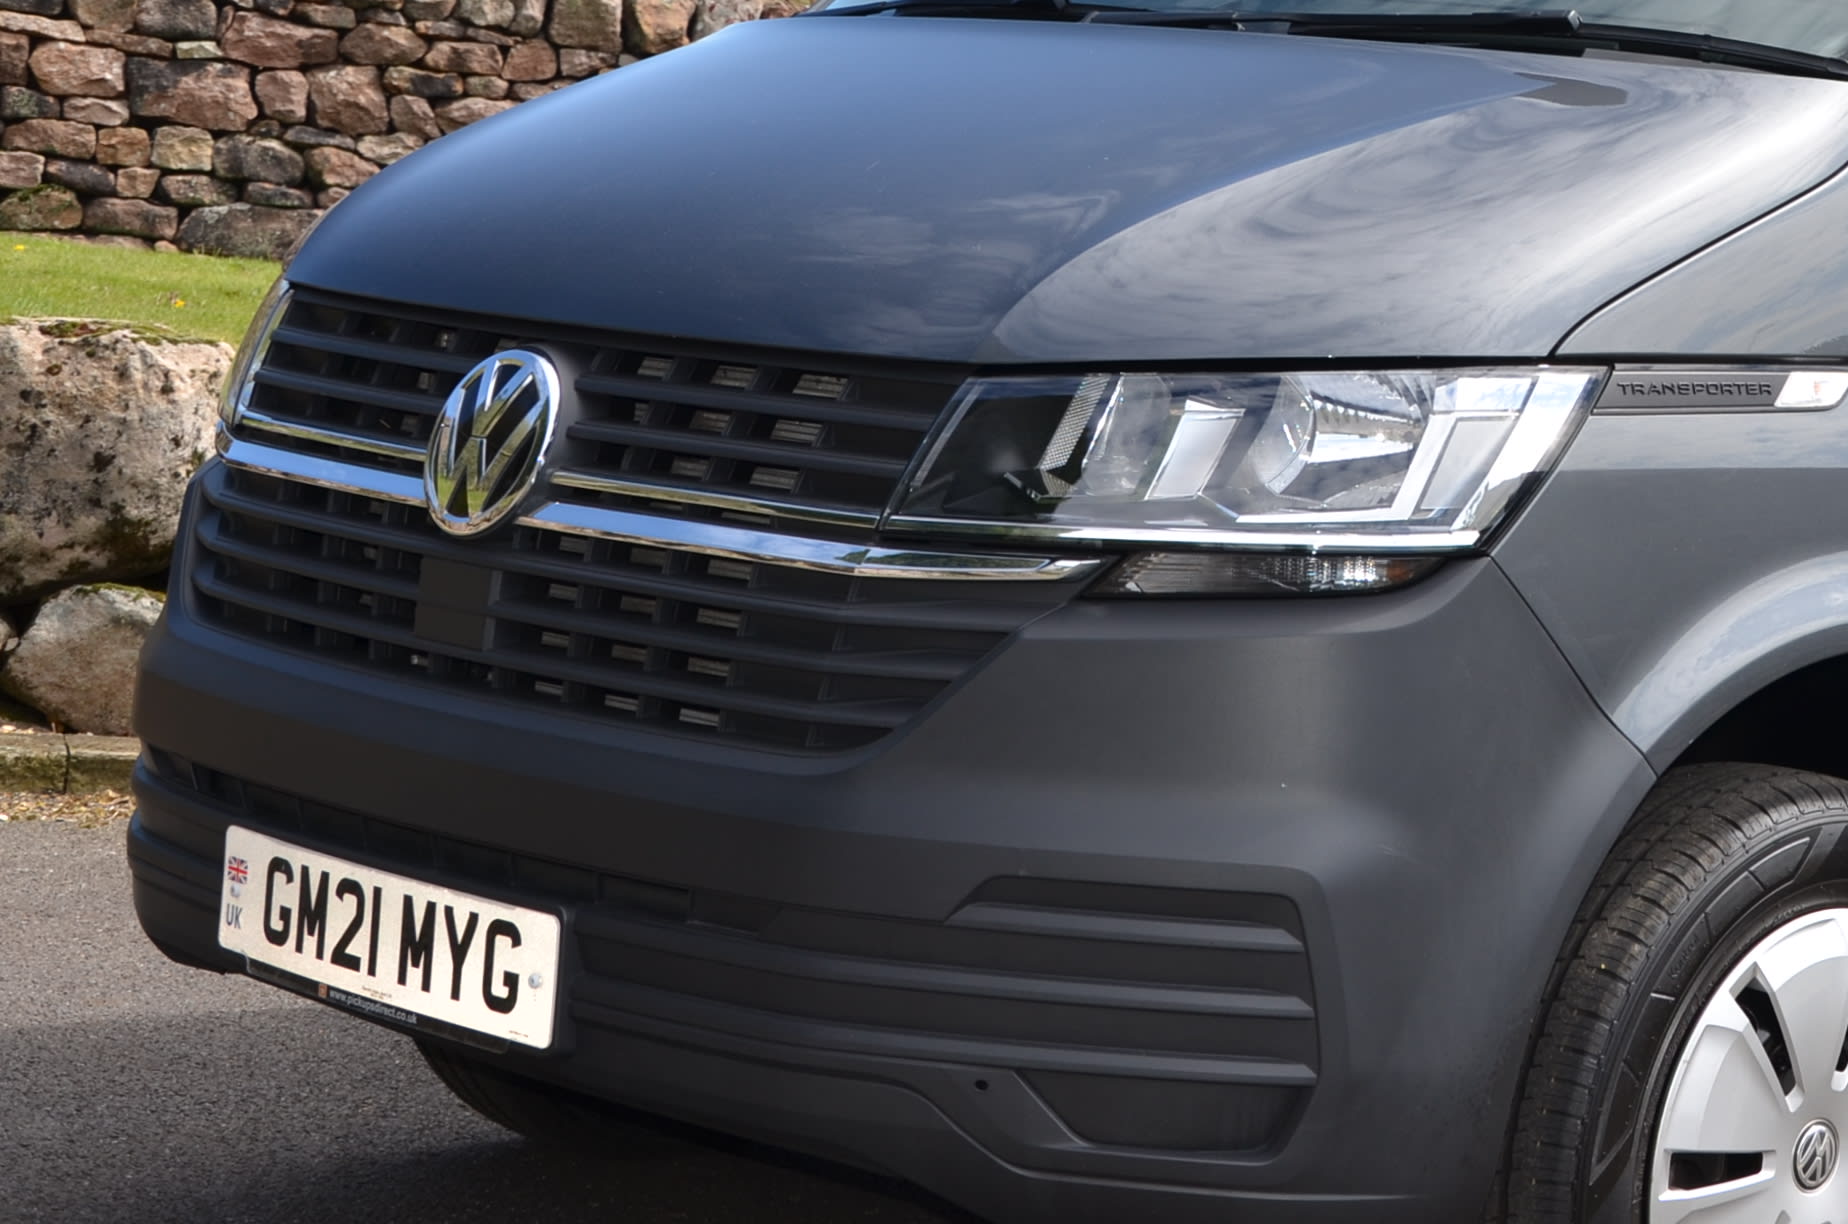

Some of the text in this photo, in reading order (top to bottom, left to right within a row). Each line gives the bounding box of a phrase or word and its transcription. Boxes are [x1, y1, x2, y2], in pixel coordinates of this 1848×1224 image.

[1616, 381, 1773, 397] TRANSPORTER
[424, 349, 560, 535] VW
[225, 903, 243, 930] UK
[263, 856, 522, 1015] GM21 MYG
